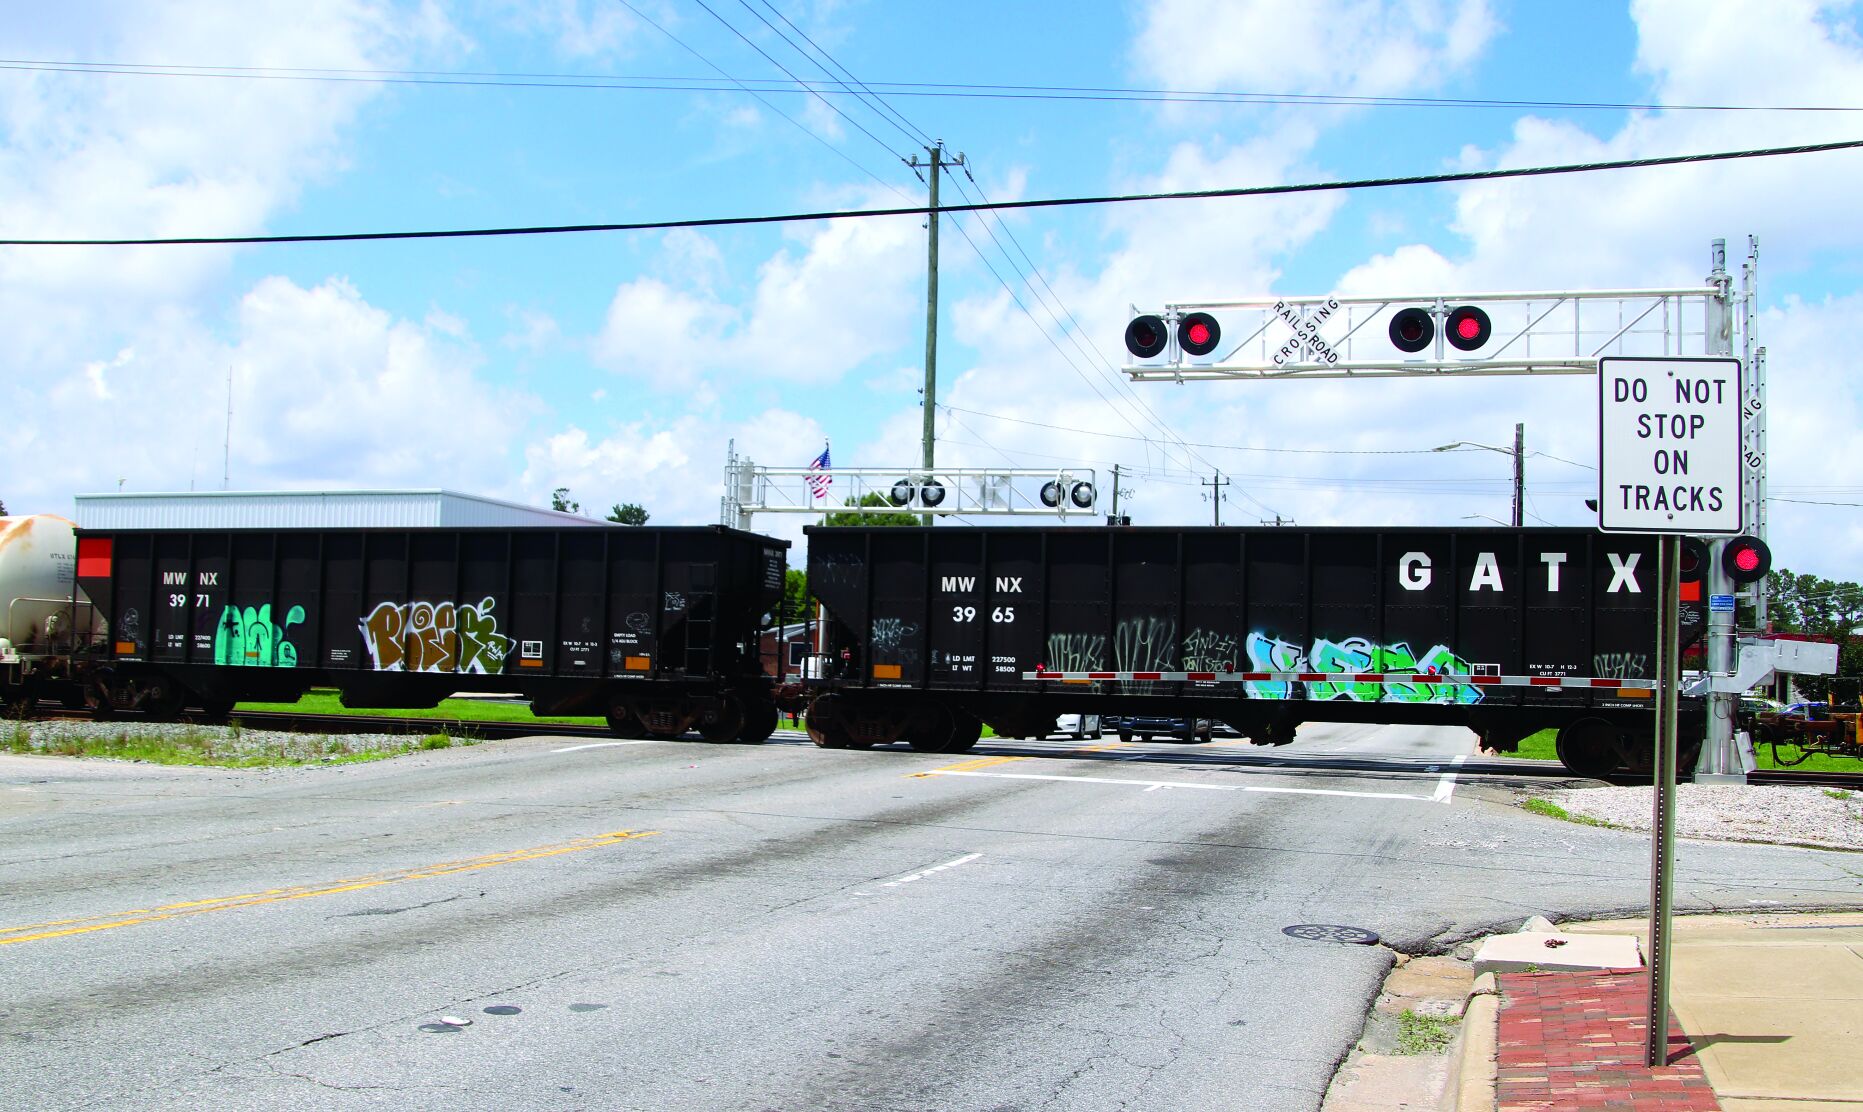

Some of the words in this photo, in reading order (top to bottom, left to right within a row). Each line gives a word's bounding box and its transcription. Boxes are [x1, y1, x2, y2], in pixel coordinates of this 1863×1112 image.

[1273, 301, 1301, 330] RAIL
[1308, 334, 1338, 363] ROAD
[1273, 299, 1338, 365] CROSSING
[1614, 378, 1648, 403] DO
[1675, 379, 1726, 404] NOT
[1637, 413, 1705, 439] STOP
[1654, 449, 1688, 475] ON
[1744, 445, 1761, 468] AD
[1619, 484, 1723, 511] TRACKS
[163, 572, 187, 585] MW
[199, 572, 218, 585] NX
[941, 576, 976, 592] MW
[995, 577, 1023, 593] NX
[169, 594, 187, 607] 39
[195, 594, 209, 608] 71
[952, 606, 976, 622] 39
[991, 606, 1015, 623] 65
